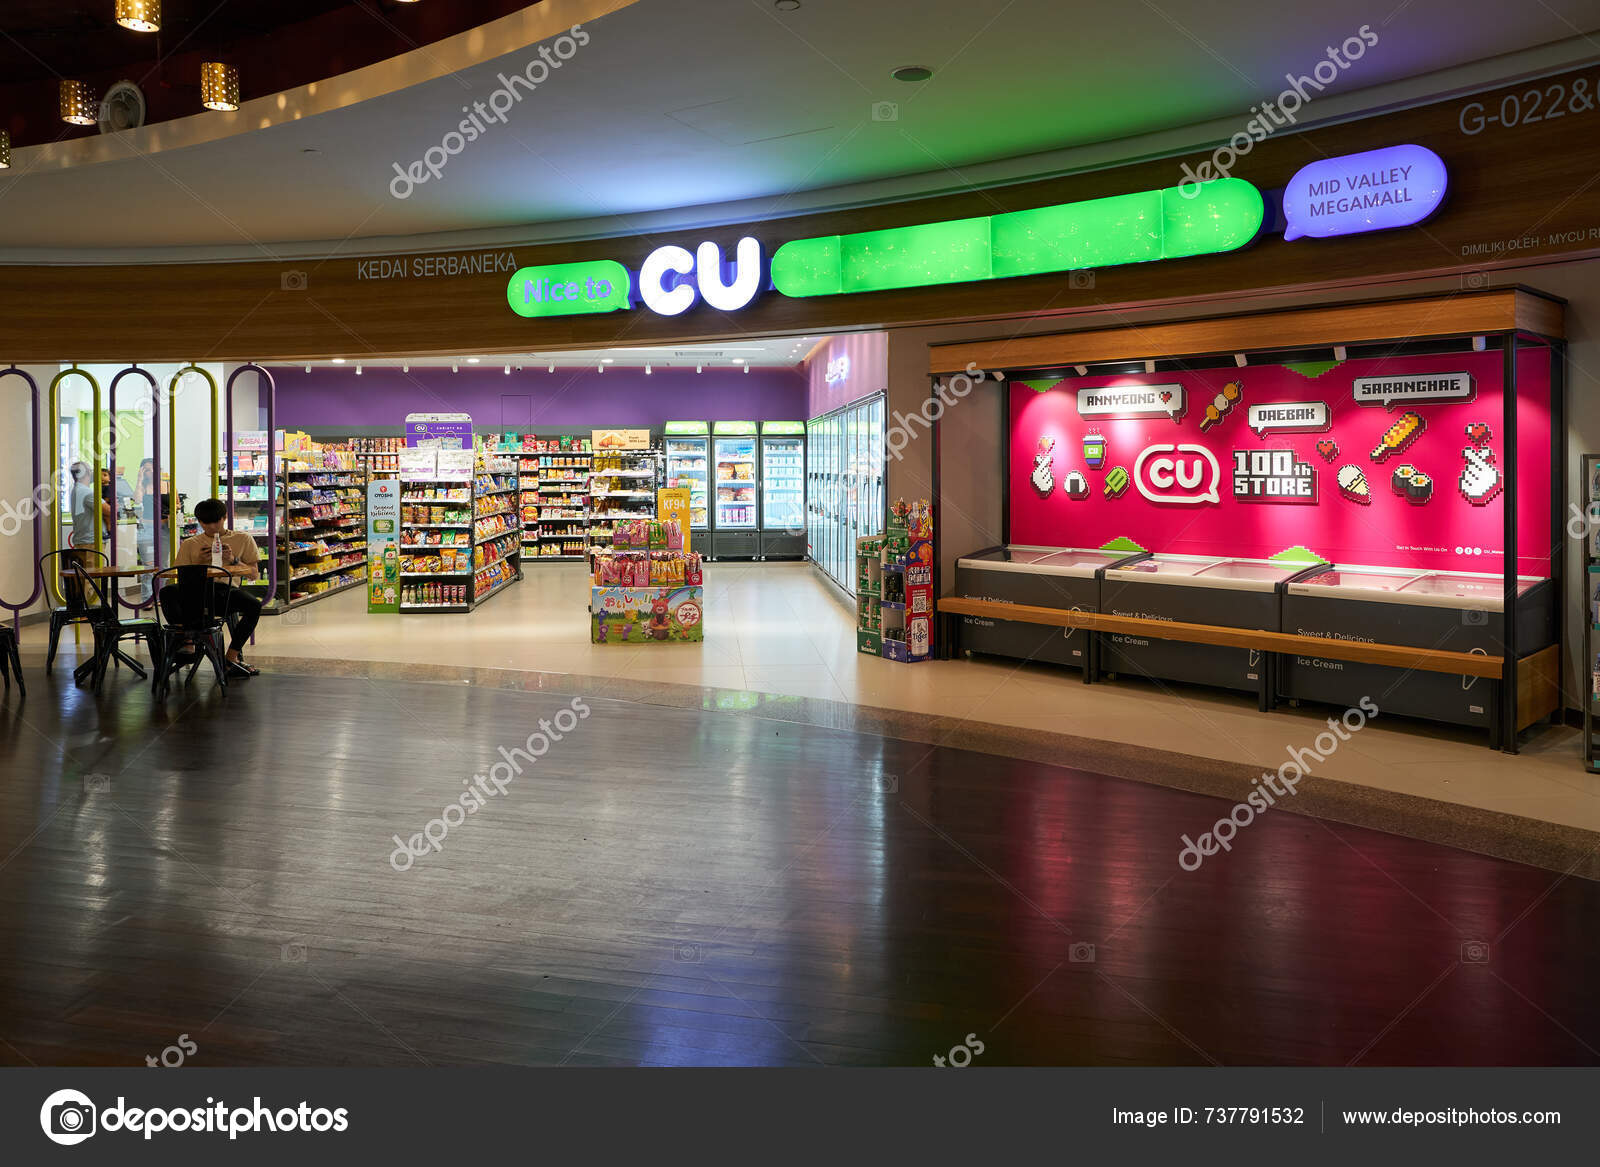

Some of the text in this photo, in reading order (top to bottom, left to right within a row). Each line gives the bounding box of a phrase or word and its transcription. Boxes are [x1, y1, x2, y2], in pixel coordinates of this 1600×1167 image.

[1459, 78, 1600, 135] G-022&
[1309, 165, 1412, 198] MID VALLEY
[1310, 187, 1413, 217] MEGAMALL
[1461, 241, 1505, 257] DIMILIKI
[1508, 237, 1540, 250] OLEH
[1549, 231, 1585, 246] MYCU
[357, 252, 518, 280] KEDAI SERBANEKA
[524, 236, 761, 316] Nice to CU
[1361, 379, 1460, 394] SARANGHAE
[1087, 392, 1155, 407] ANNYEONG
[1258, 408, 1315, 421] DAEBAK
[1149, 458, 1203, 489] CU
[1234, 477, 1312, 496] STORE
[663, 499, 686, 511] KF94
[1112, 635, 1149, 647] Ice Cream
[1297, 656, 1344, 671] Ice Cream
